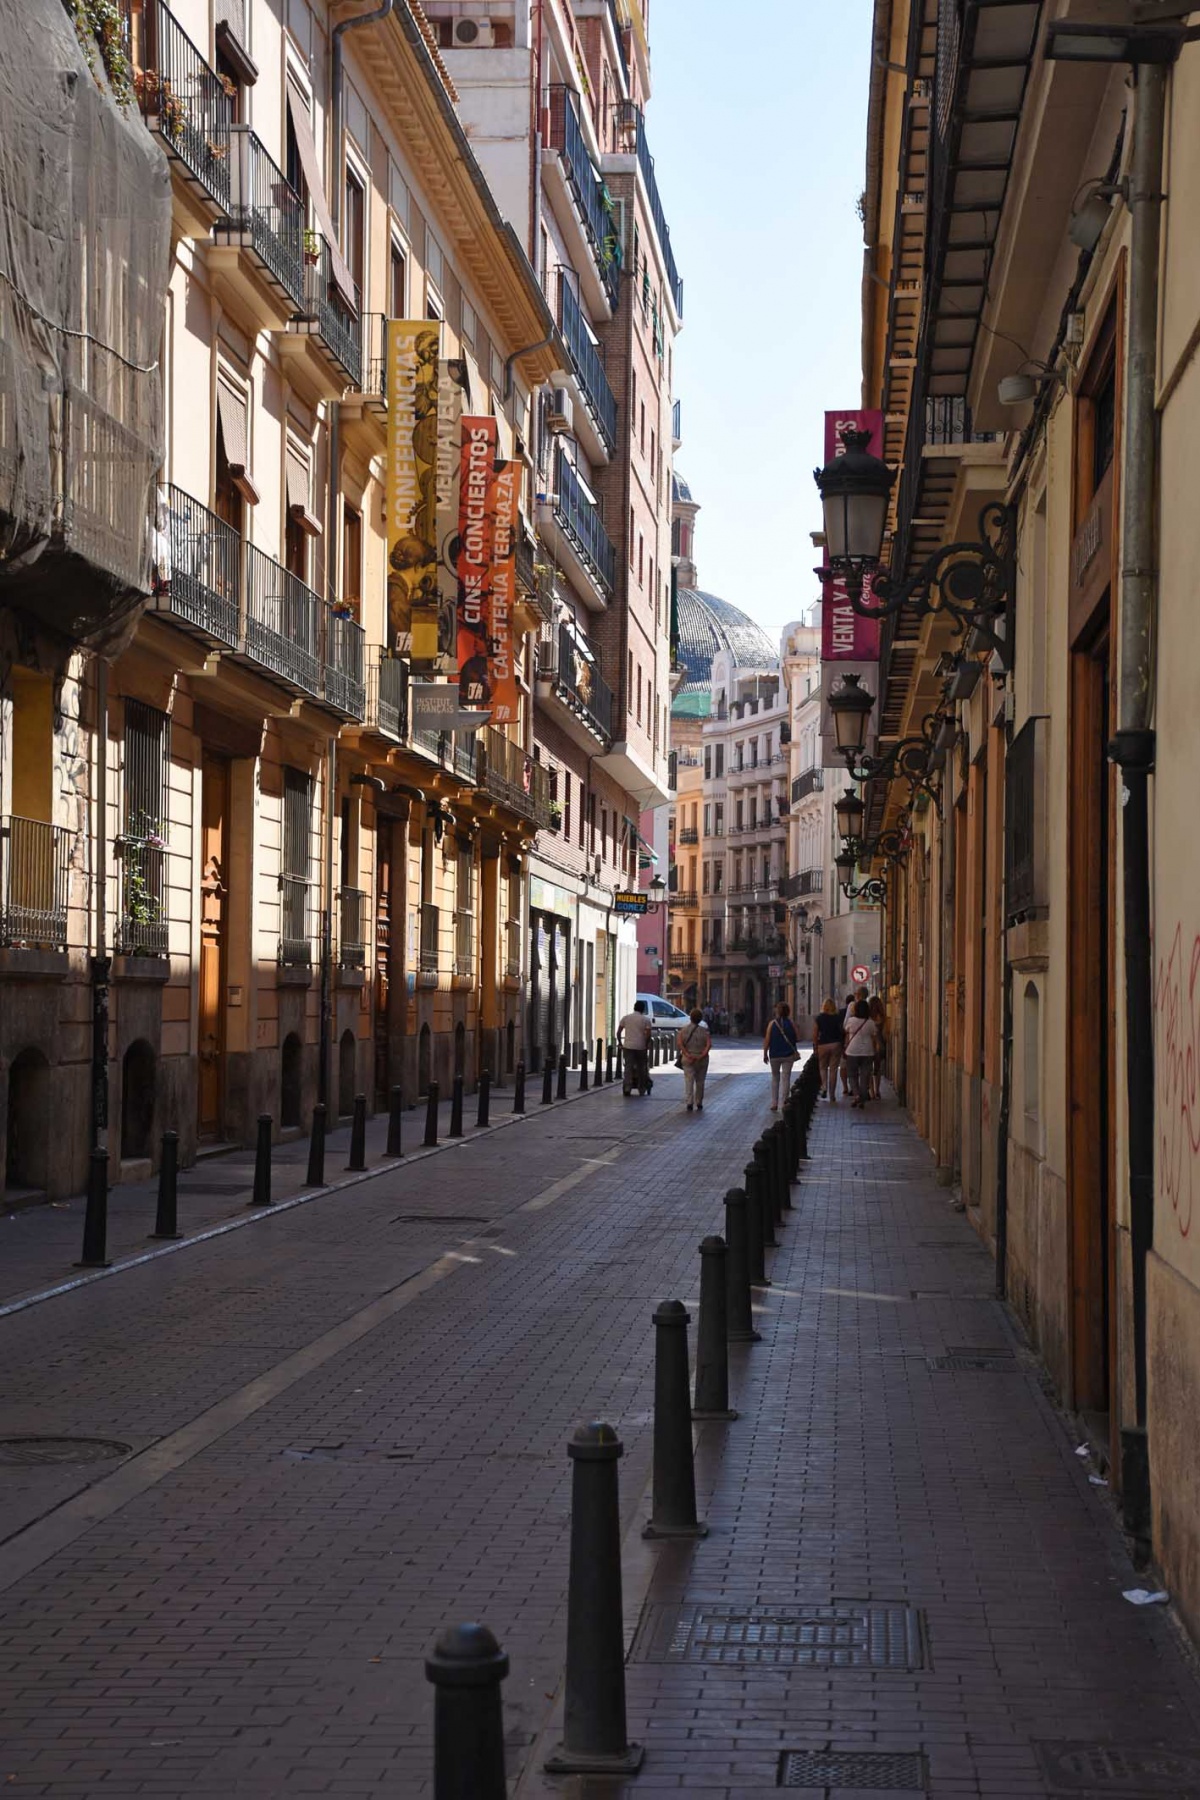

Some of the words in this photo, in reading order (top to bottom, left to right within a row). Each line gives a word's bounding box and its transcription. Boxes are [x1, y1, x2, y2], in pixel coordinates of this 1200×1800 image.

[395, 335, 416, 529] CONFERENCIAS
[436, 376, 455, 512] MEDIATECA
[465, 428, 489, 564] CONCIERTOS
[494, 472, 514, 567] TERRAZA
[465, 574, 482, 624] CINE
[490, 572, 509, 680] CAFETERÍA
[832, 605, 855, 653] VENTA
